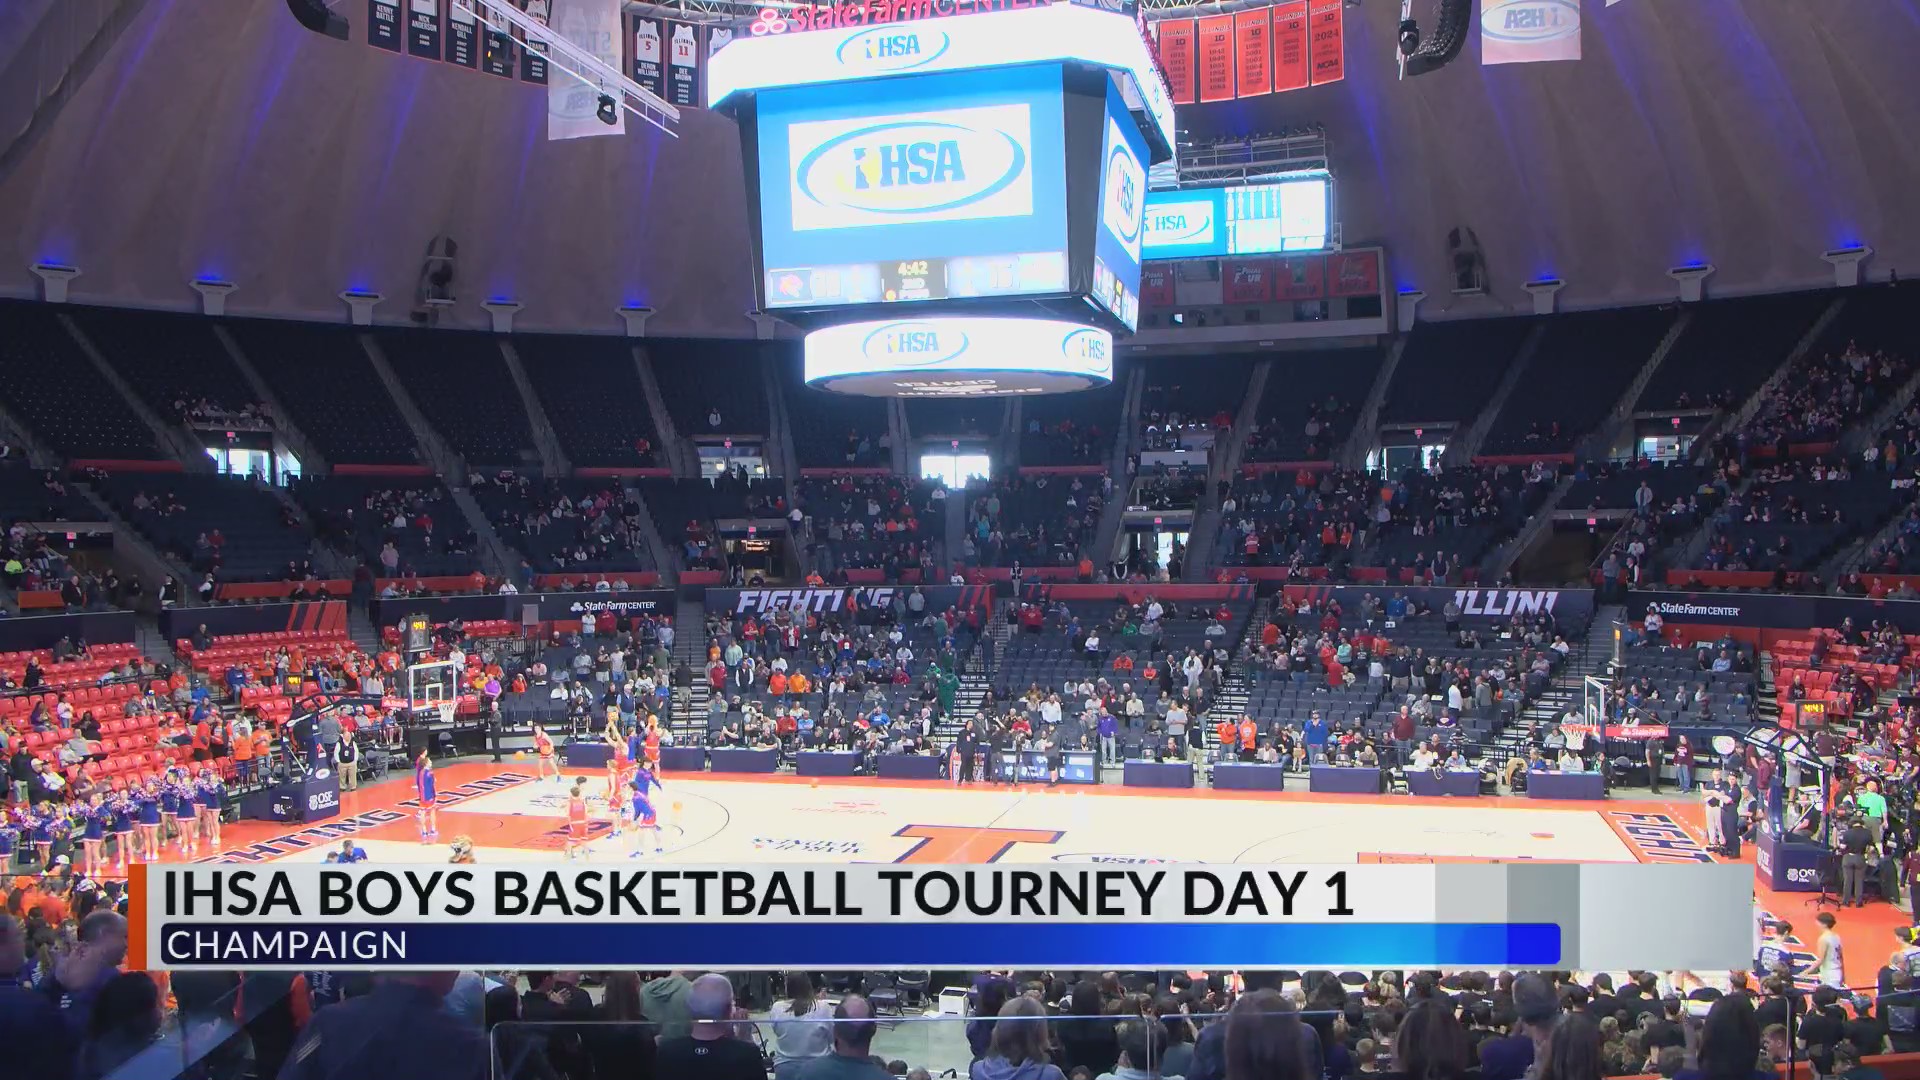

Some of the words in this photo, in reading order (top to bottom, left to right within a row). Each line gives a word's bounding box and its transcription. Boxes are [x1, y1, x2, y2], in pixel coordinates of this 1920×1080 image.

[645, 41, 651, 50] 5
[678, 46, 689, 56] 11
[898, 260, 928, 276] 4:42
[628, 601, 655, 609] CENTER
[1454, 590, 1559, 615] ILLINI
[1707, 606, 1739, 616] CENTER
[318, 791, 333, 804] OSF
